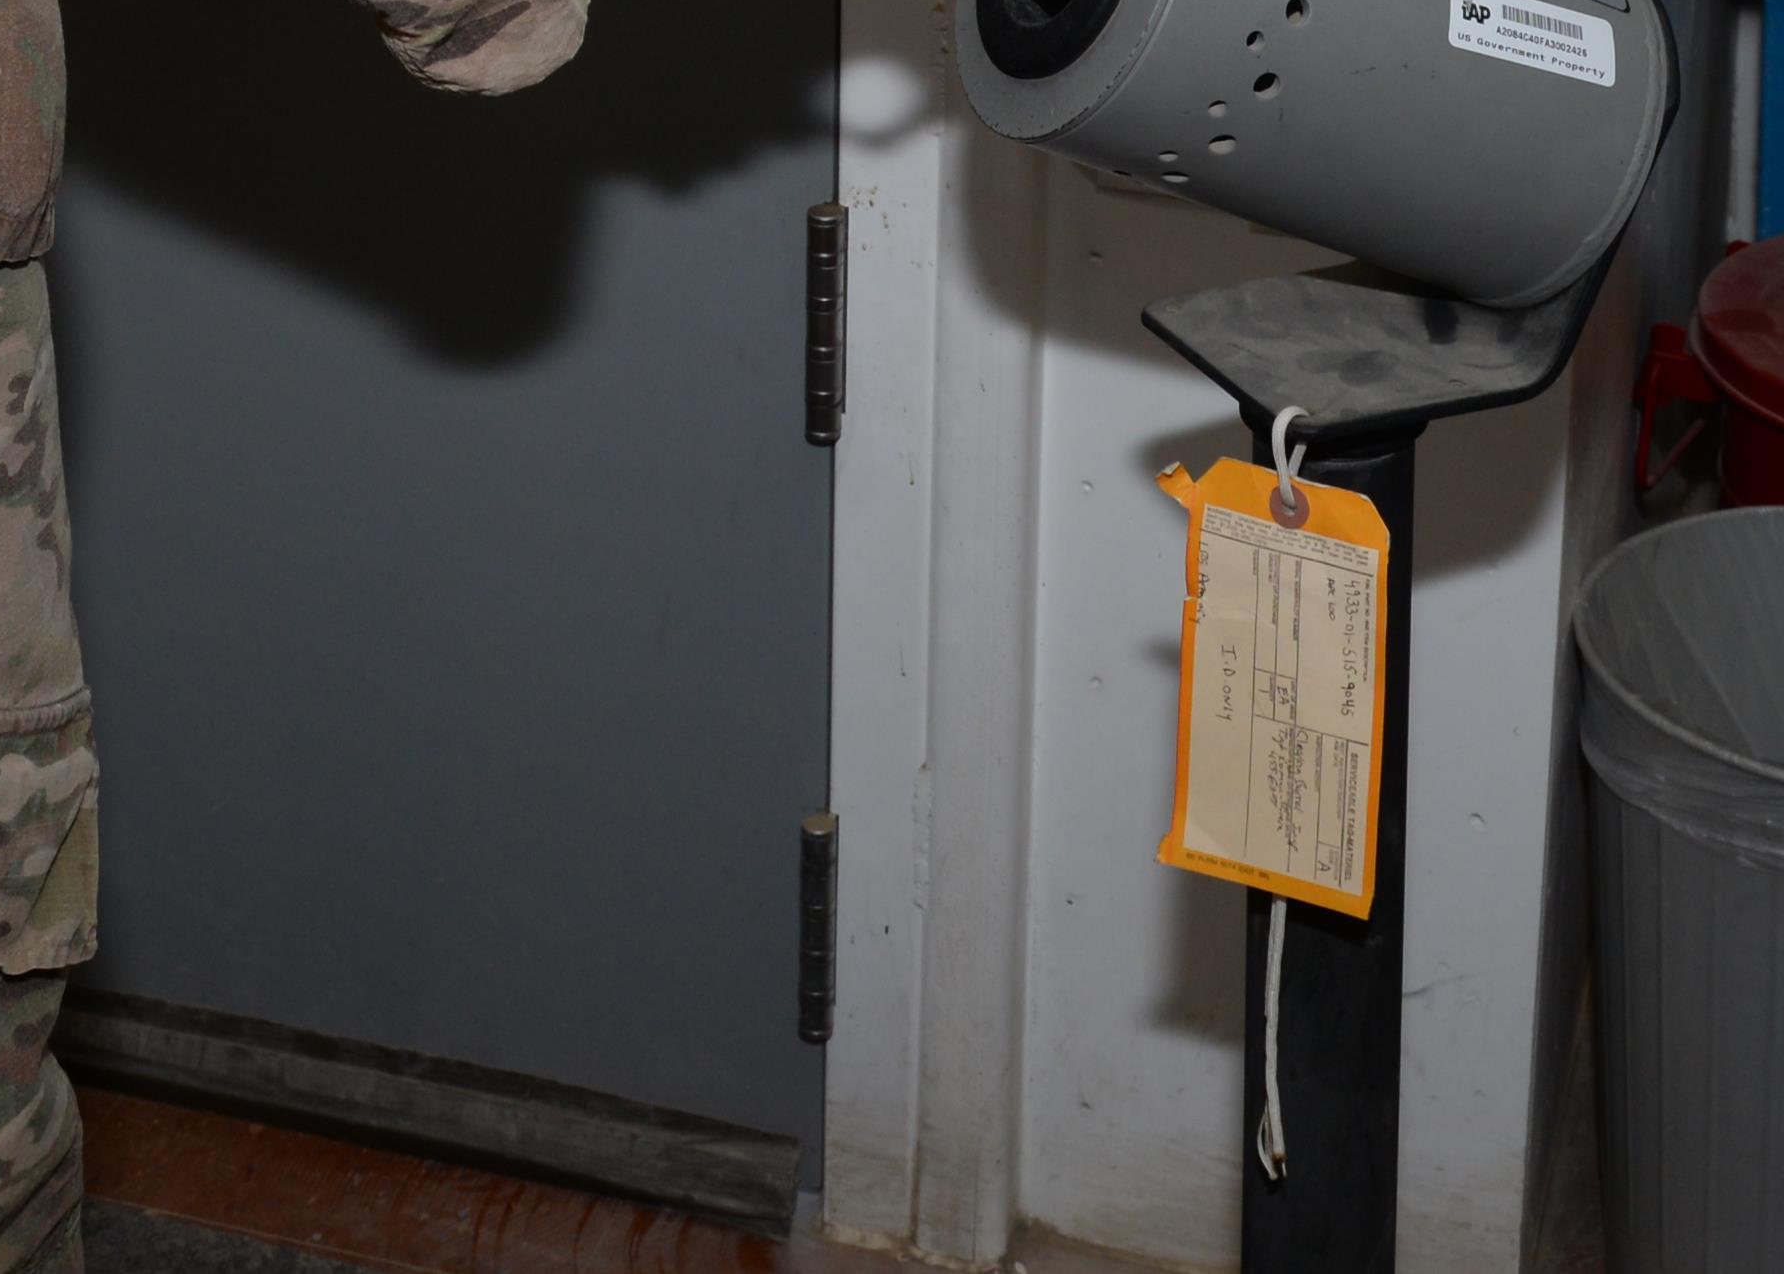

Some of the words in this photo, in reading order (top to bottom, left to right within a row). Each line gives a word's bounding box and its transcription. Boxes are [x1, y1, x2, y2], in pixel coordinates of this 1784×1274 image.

[1457, 32, 1471, 43] US
[1477, 35, 1546, 62] Government
[1551, 57, 1606, 79] Property
[1347, 752, 1359, 813] SERVICEABLE
